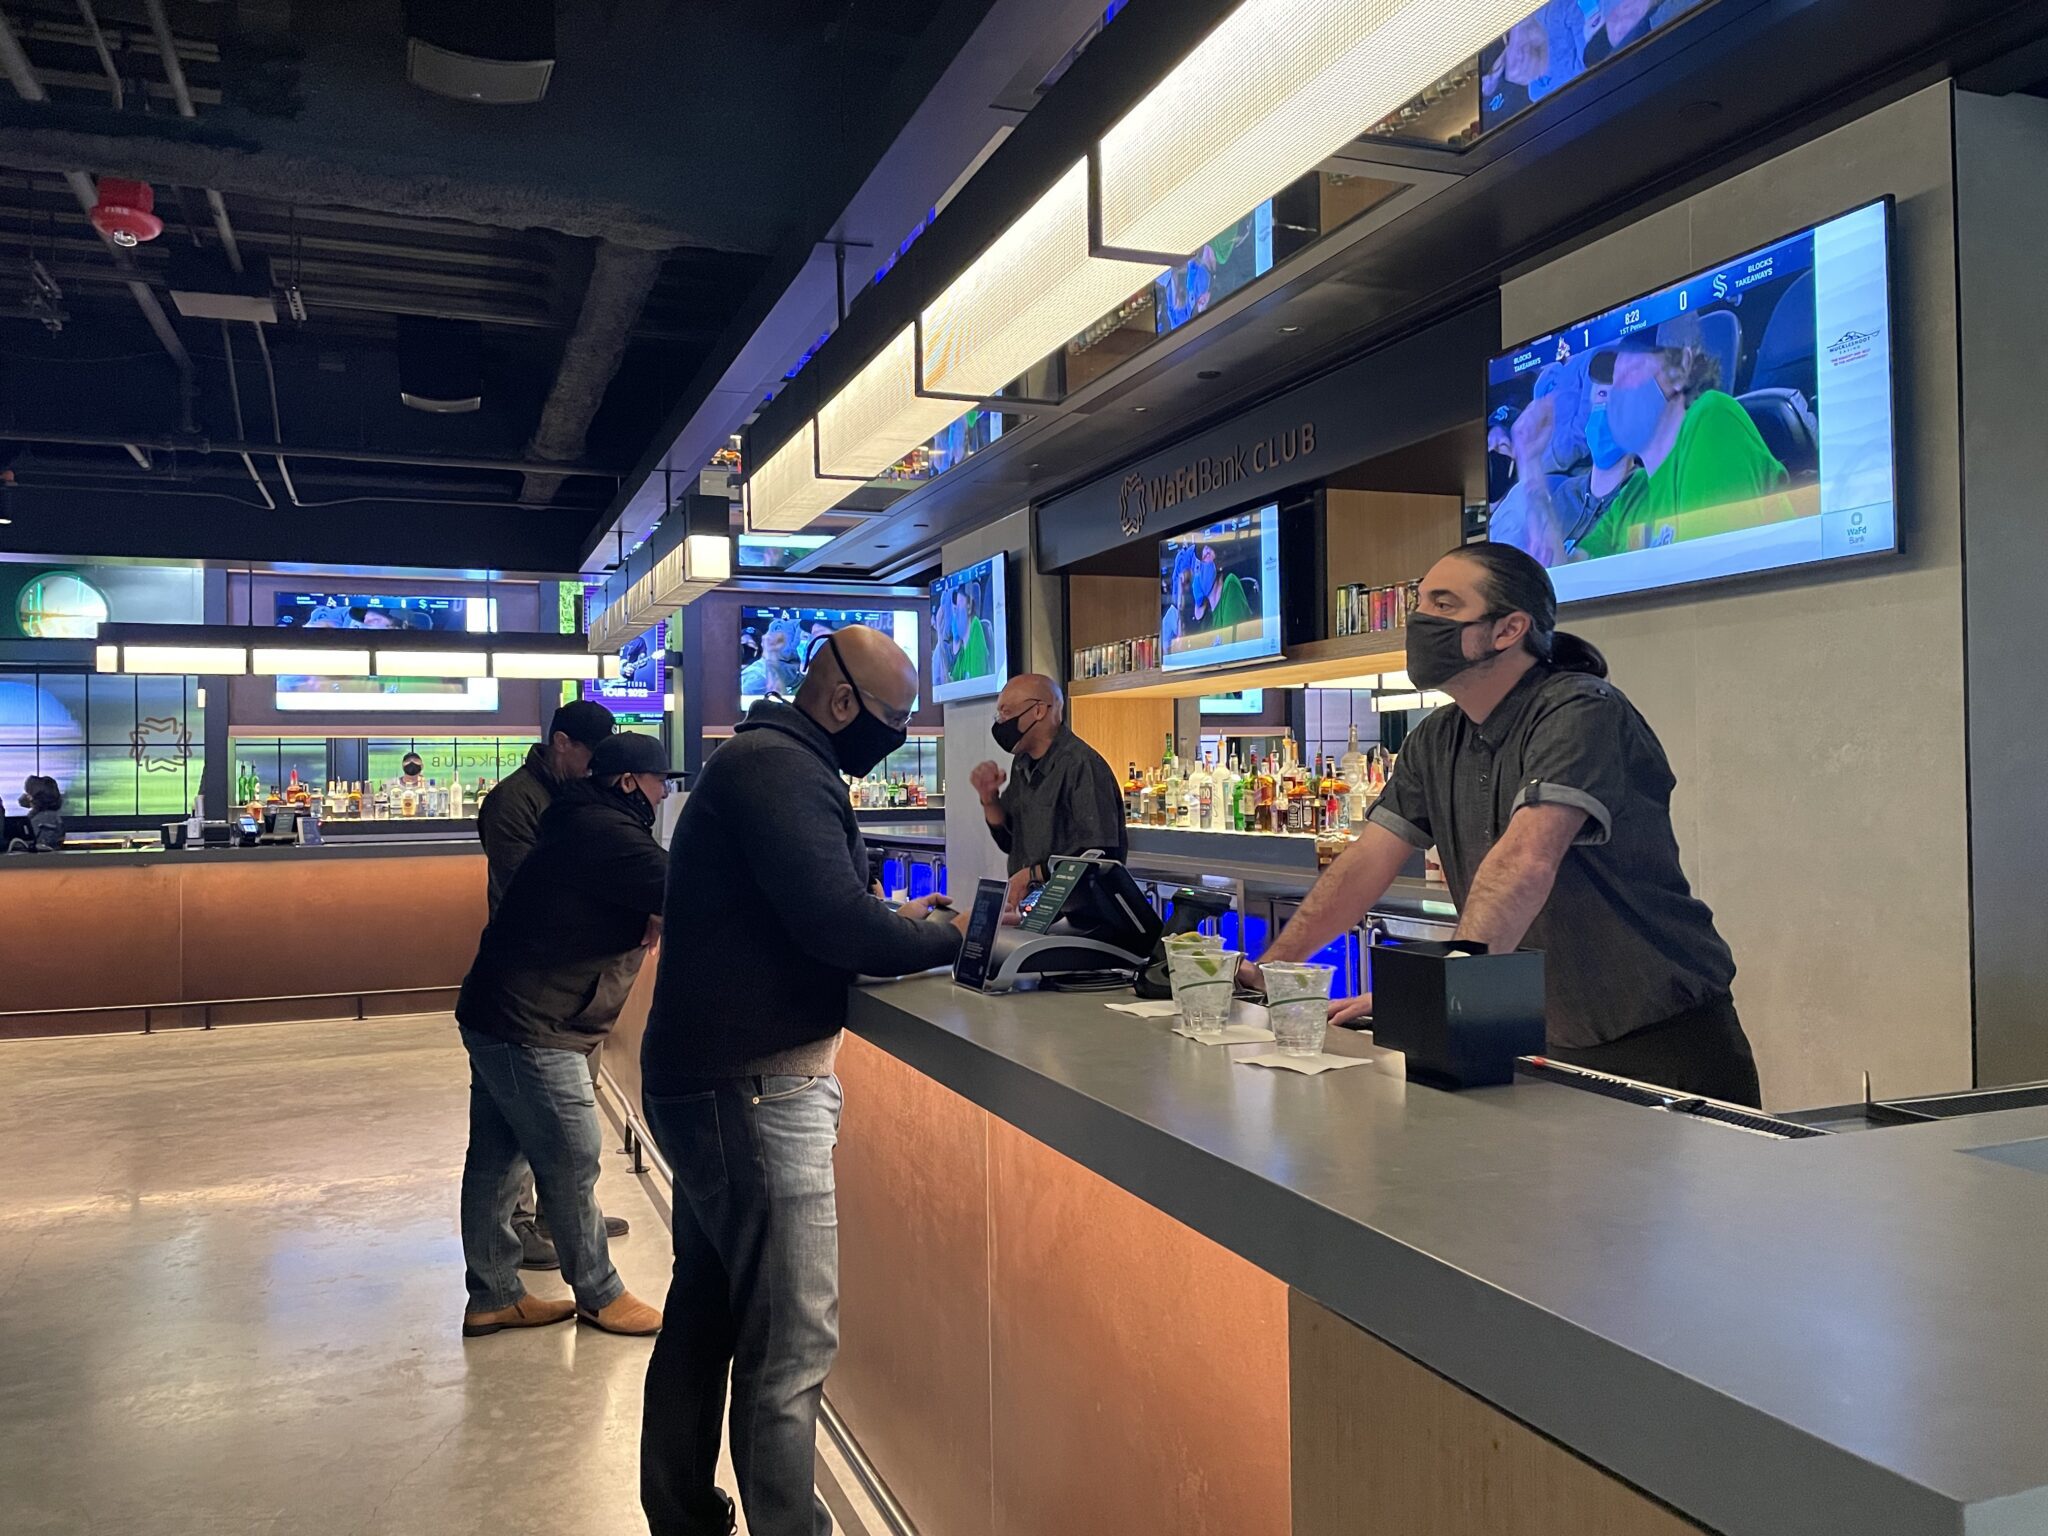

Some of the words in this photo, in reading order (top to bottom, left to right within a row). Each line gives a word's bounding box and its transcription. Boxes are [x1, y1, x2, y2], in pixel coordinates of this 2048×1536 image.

[1747, 257, 1773, 274] BLOCKS
[1734, 268, 1773, 288] TAKEAWAYS
[1679, 290, 1688, 311] 0
[1624, 308, 1641, 326] 8:23
[1583, 328, 1589, 348] 1
[1513, 351, 1532, 365] BLOCKS
[1514, 357, 1542, 373] TAKEAWAYS
[1252, 422, 1316, 474] CLUB
[1846, 526, 1867, 536] WaFd
[1848, 535, 1865, 545] Bank
[602, 687, 627, 698] TOUR
